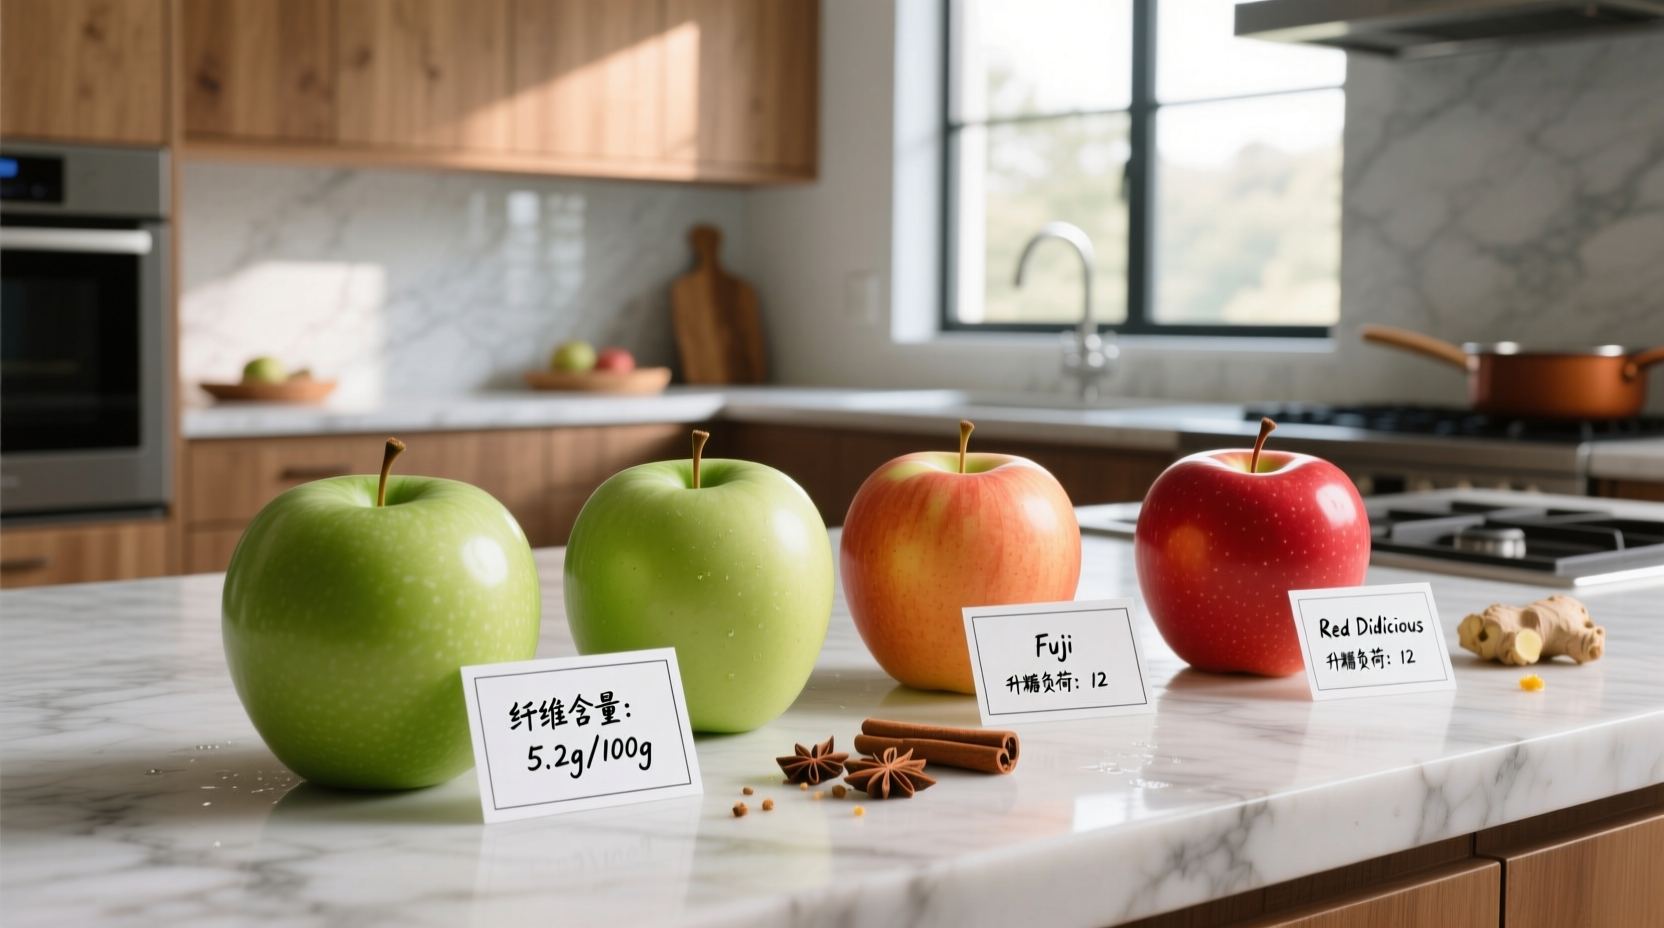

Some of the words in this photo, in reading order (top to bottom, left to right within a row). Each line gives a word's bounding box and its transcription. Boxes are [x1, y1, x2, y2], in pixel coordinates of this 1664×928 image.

[1319, 617, 1350, 639] Red
[1035, 633, 1073, 662] Fuji
[1400, 649, 1416, 664] 12
[1091, 671, 1109, 688] 12
[527, 734, 652, 779] 5.2g/100g
